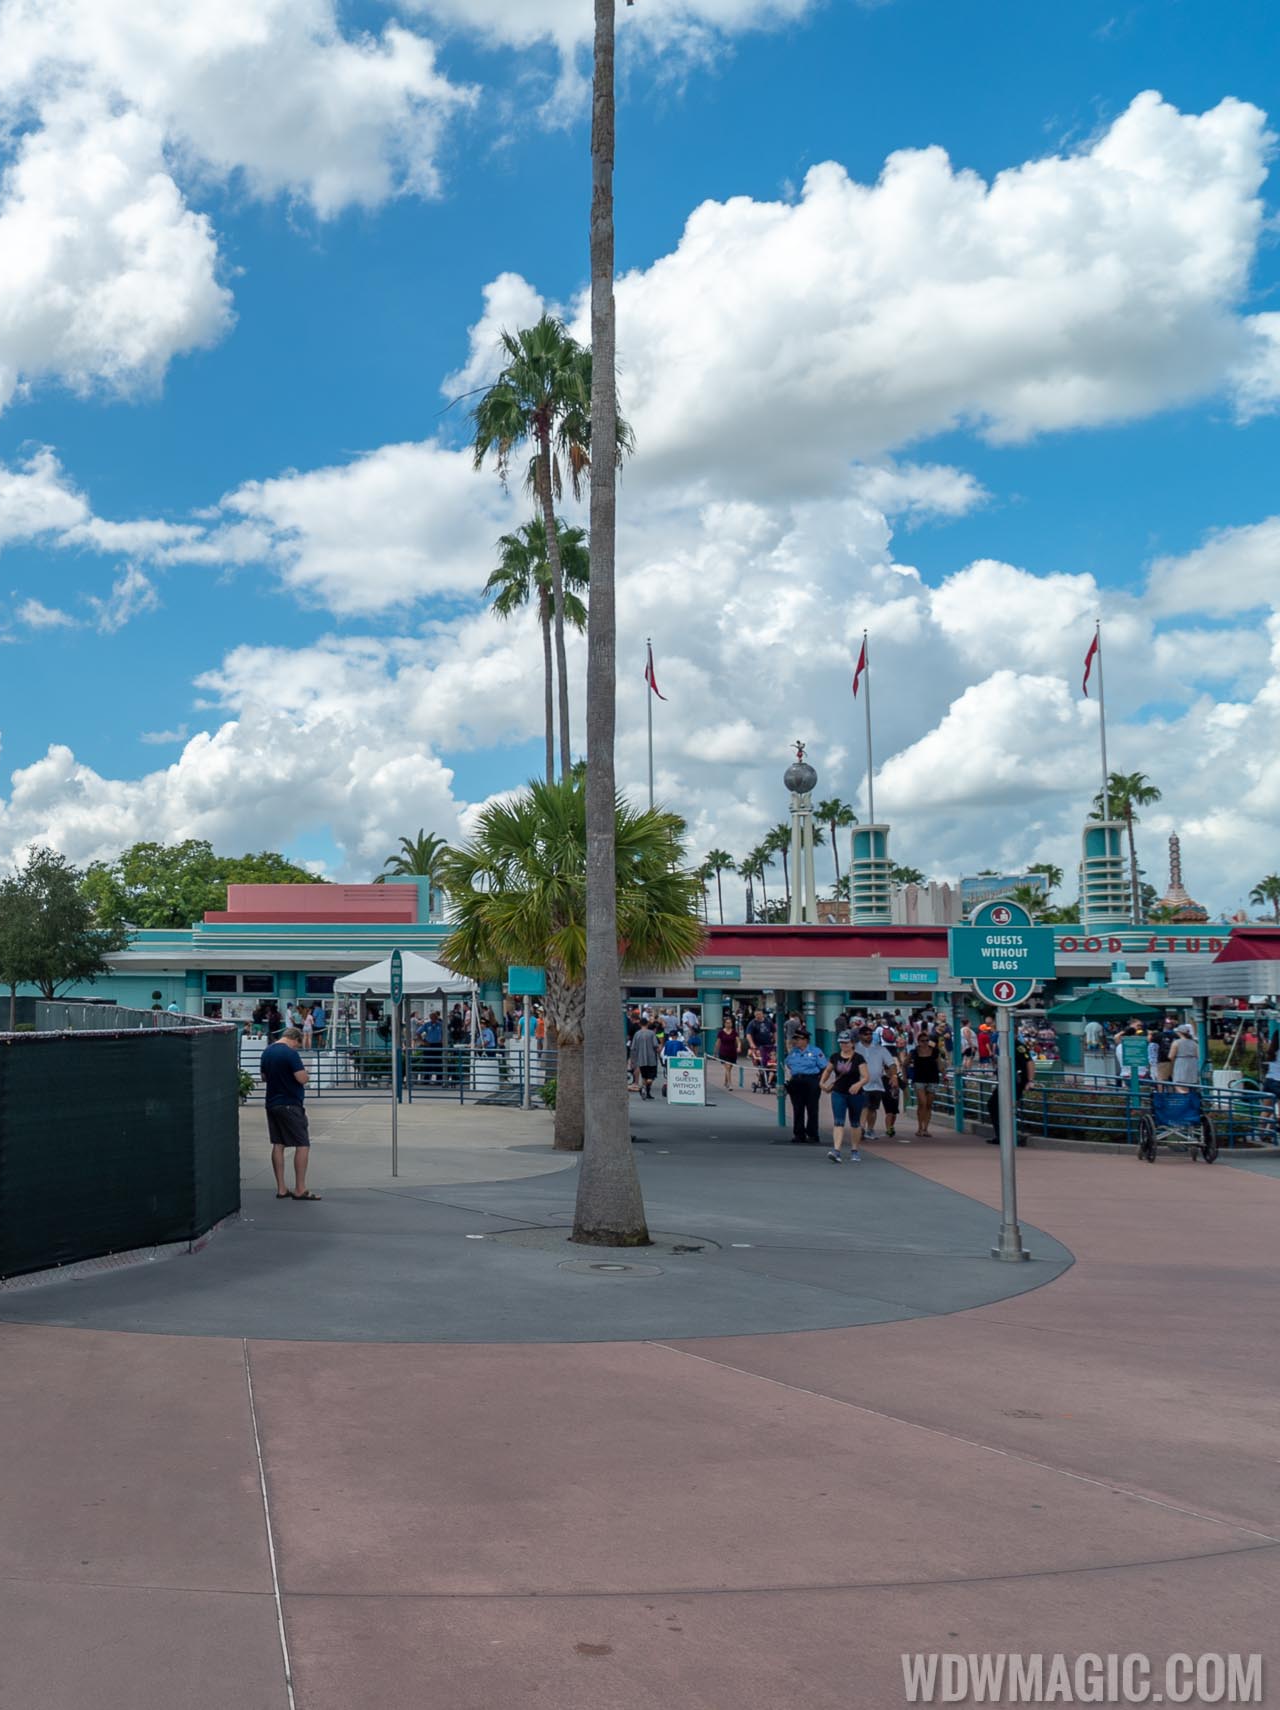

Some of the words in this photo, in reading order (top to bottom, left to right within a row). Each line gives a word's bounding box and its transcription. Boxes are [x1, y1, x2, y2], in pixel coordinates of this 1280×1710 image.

[985, 935, 1023, 945] GUESTS
[1059, 936, 1122, 953] OOD
[1146, 936, 1224, 953] STUD
[980, 947, 1029, 958] WITHOUT
[991, 960, 1019, 970] BAGS
